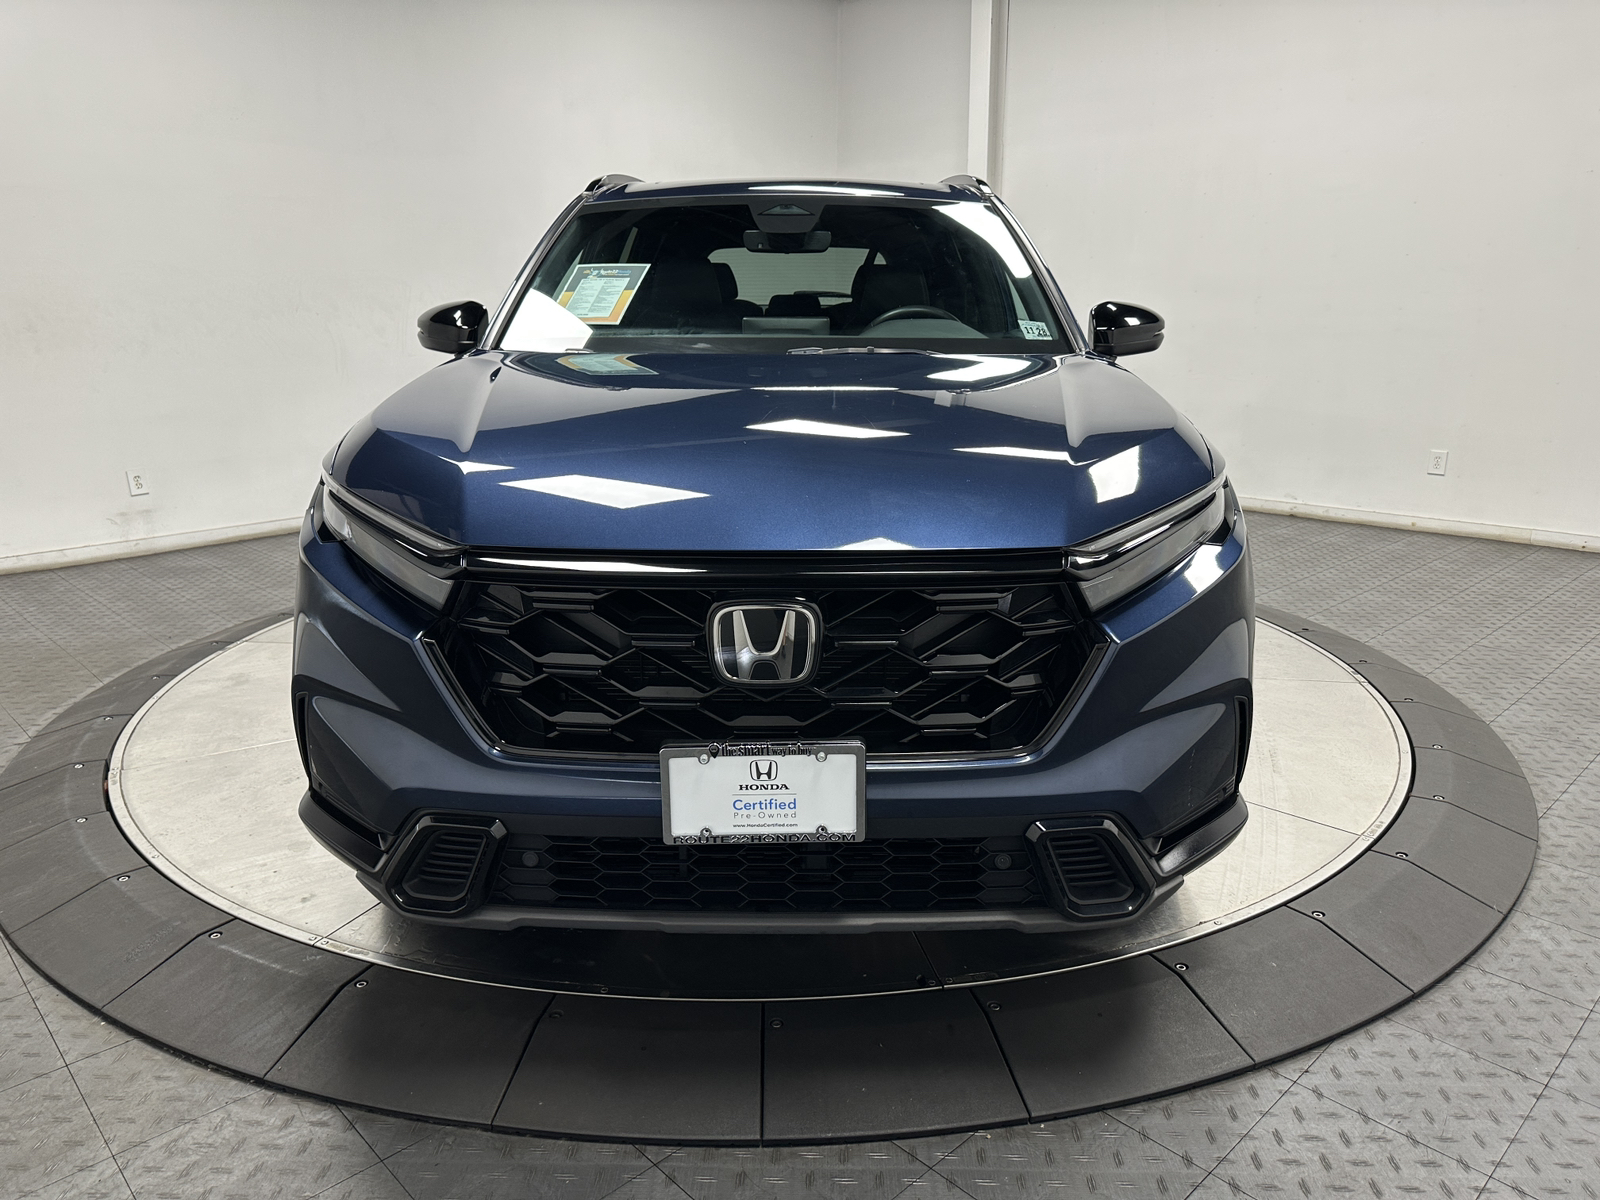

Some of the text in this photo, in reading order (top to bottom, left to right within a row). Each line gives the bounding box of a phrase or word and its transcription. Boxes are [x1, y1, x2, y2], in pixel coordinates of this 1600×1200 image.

[721, 742, 813, 757] the smart way to buy
[738, 783, 790, 791] HONDA
[732, 798, 797, 811] Certified
[733, 811, 797, 819] Pre-Owned
[673, 834, 856, 844] ROUTE22HONDA.COM
